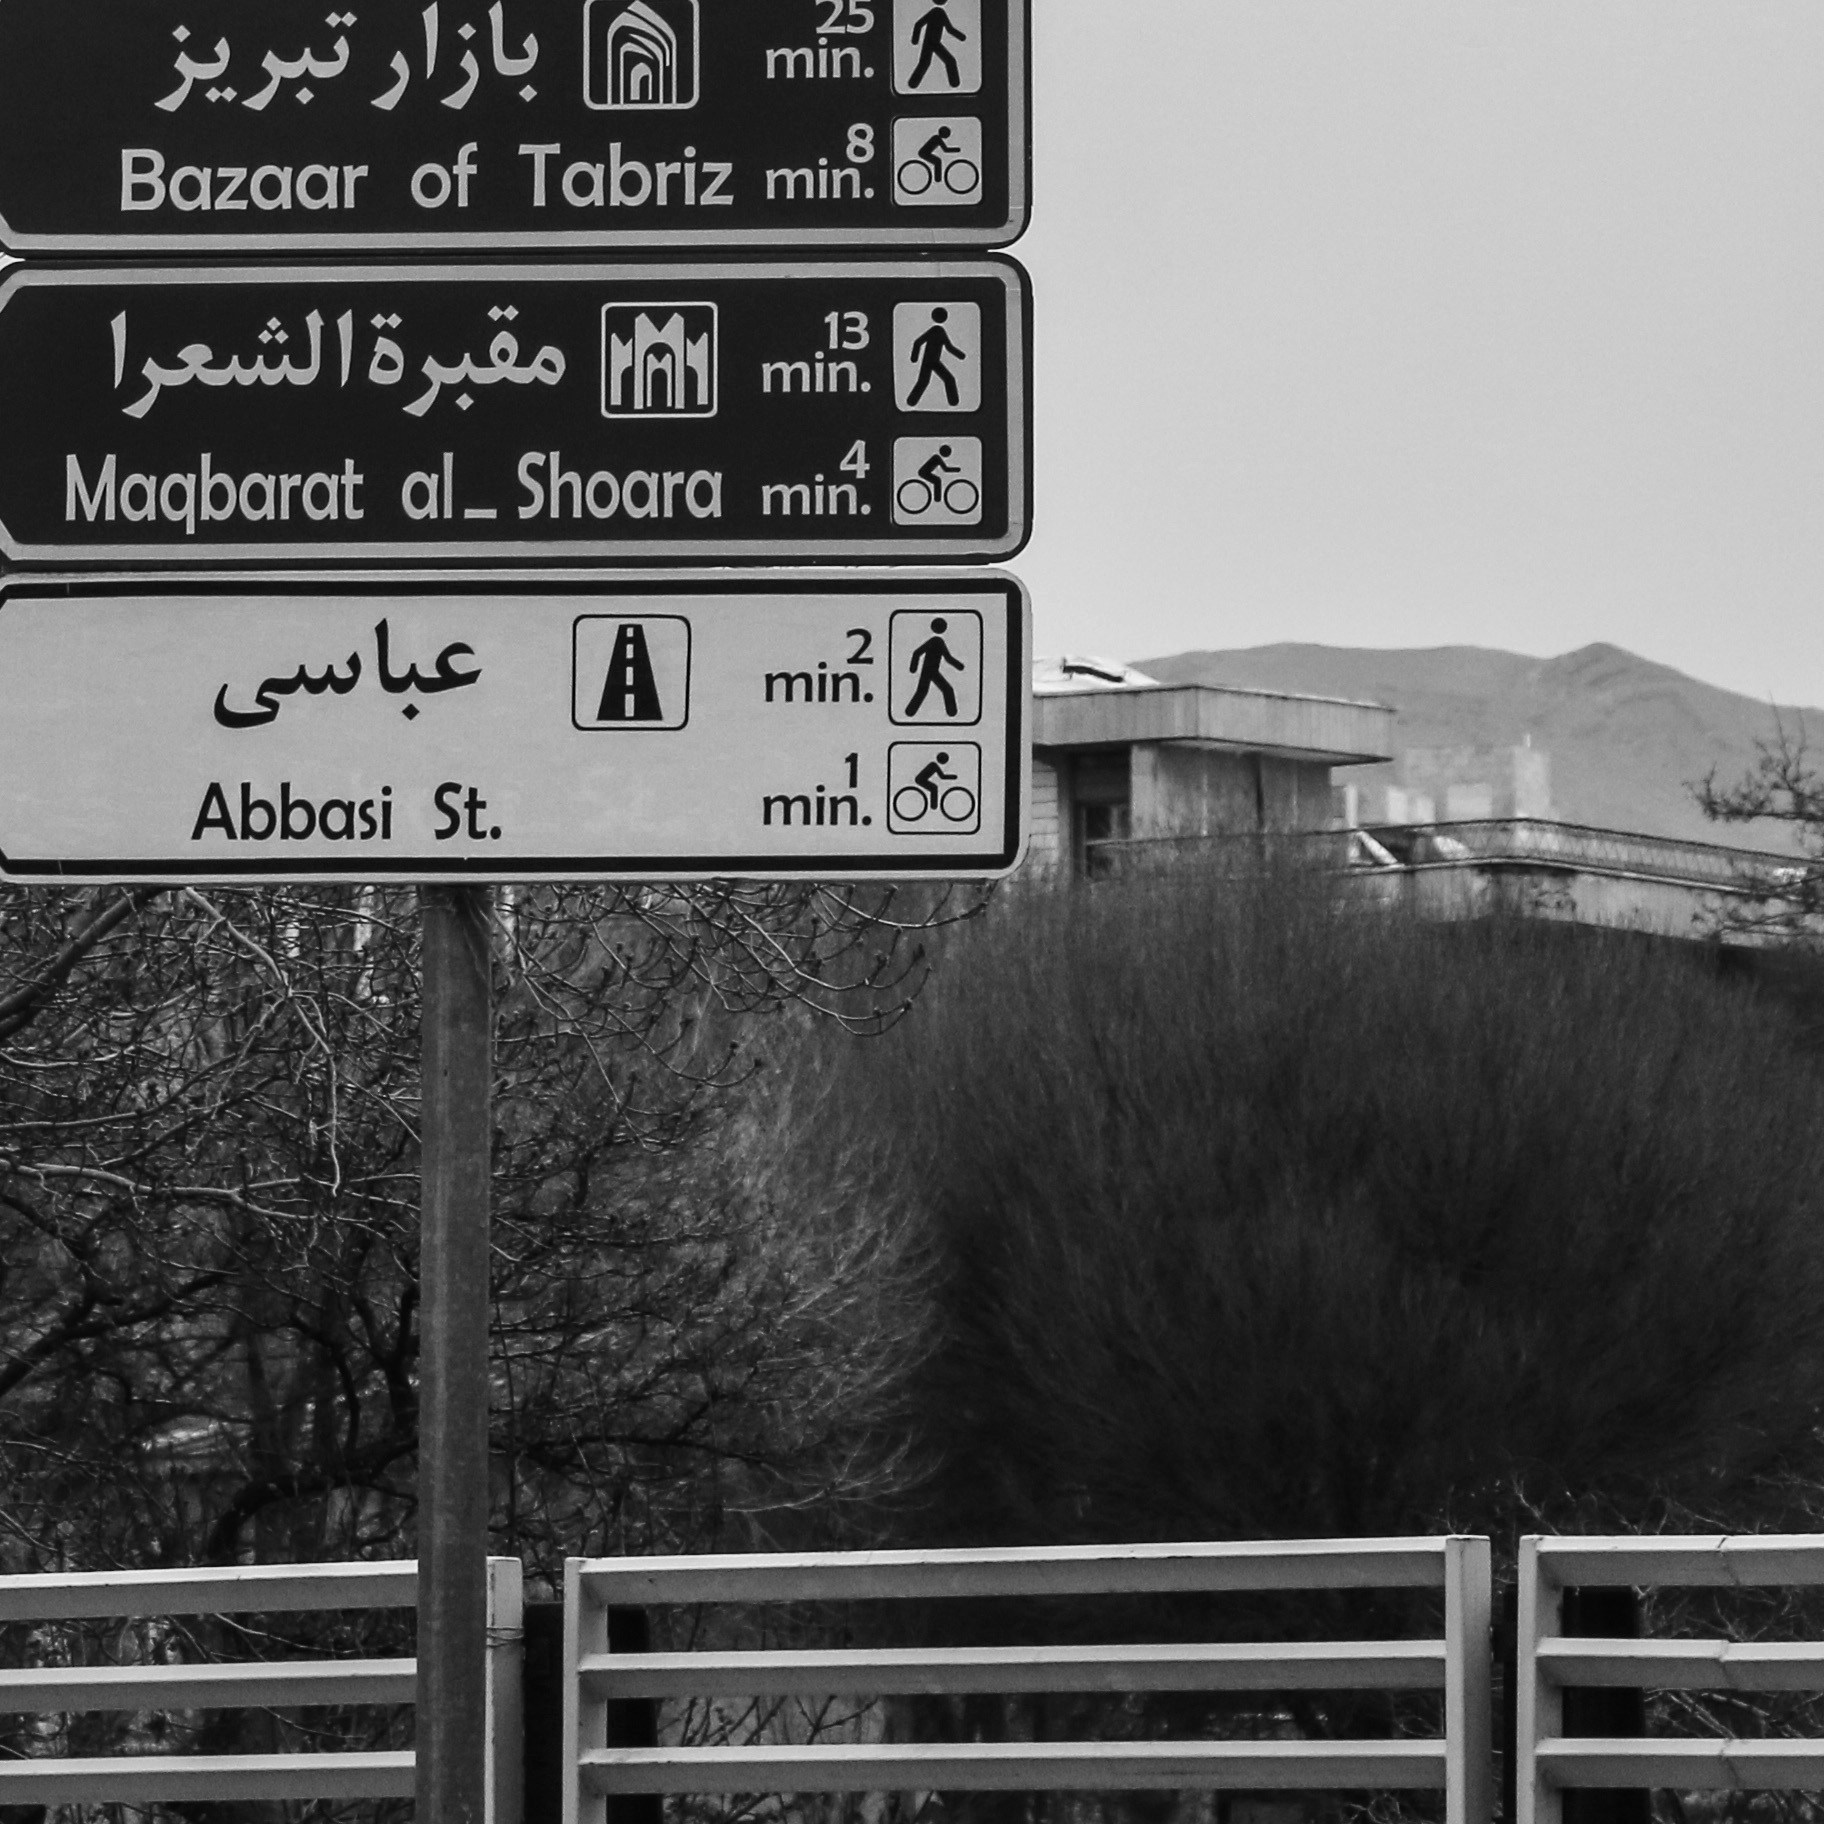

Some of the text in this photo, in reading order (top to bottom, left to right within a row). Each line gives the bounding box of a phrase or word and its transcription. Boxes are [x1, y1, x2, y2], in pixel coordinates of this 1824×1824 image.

[155, 1, 538, 112] بازار تبریز
[766, 37, 874, 78] min.
[846, 123, 874, 163] 8
[121, 142, 733, 211] Bazaar of Tabriz
[766, 158, 874, 199] min.
[825, 311, 869, 350] 13
[111, 305, 565, 418] مقبرة الشعرا
[762, 351, 871, 392] min.
[840, 440, 870, 477] 4
[66, 453, 364, 534] Maqbarat
[518, 451, 722, 519] Shoara
[762, 474, 870, 515] min.
[847, 629, 873, 664] 2
[214, 619, 481, 728] عباسی
[765, 662, 873, 702] min.
[845, 753, 858, 788] 1
[192, 782, 501, 840] Abbasi St.
[763, 785, 871, 826] min.
